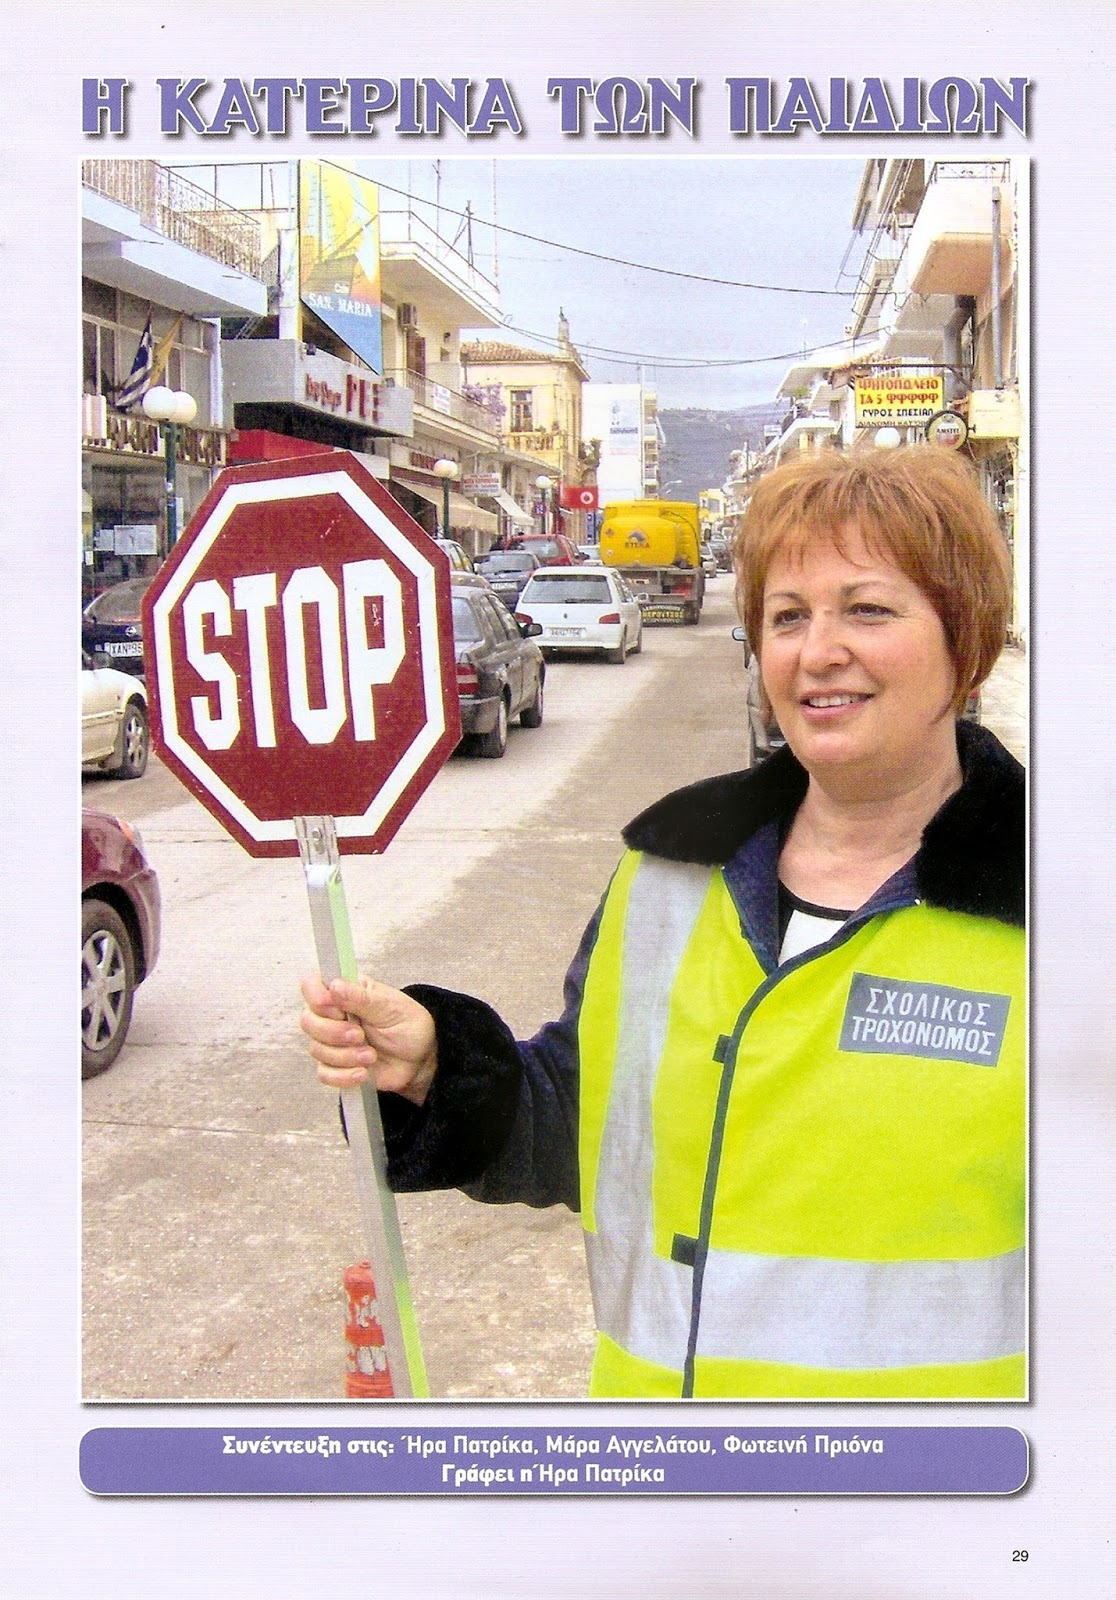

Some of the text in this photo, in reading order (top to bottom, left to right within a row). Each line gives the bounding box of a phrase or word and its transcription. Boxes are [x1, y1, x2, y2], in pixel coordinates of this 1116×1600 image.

[858, 379, 939, 391] ΨΗΤΟΠΩΛΕΙΟ
[862, 408, 934, 417] ΓΥΡΟΣ ΣΠΕΣΙΑΛ
[877, 394, 883, 405] 5
[182, 558, 407, 751] STOP
[866, 987, 991, 1027] ΣΧΟΛΙΚΟΣ
[852, 1015, 996, 1056] ΤΡΟΧΟΝΟΜΟΣ
